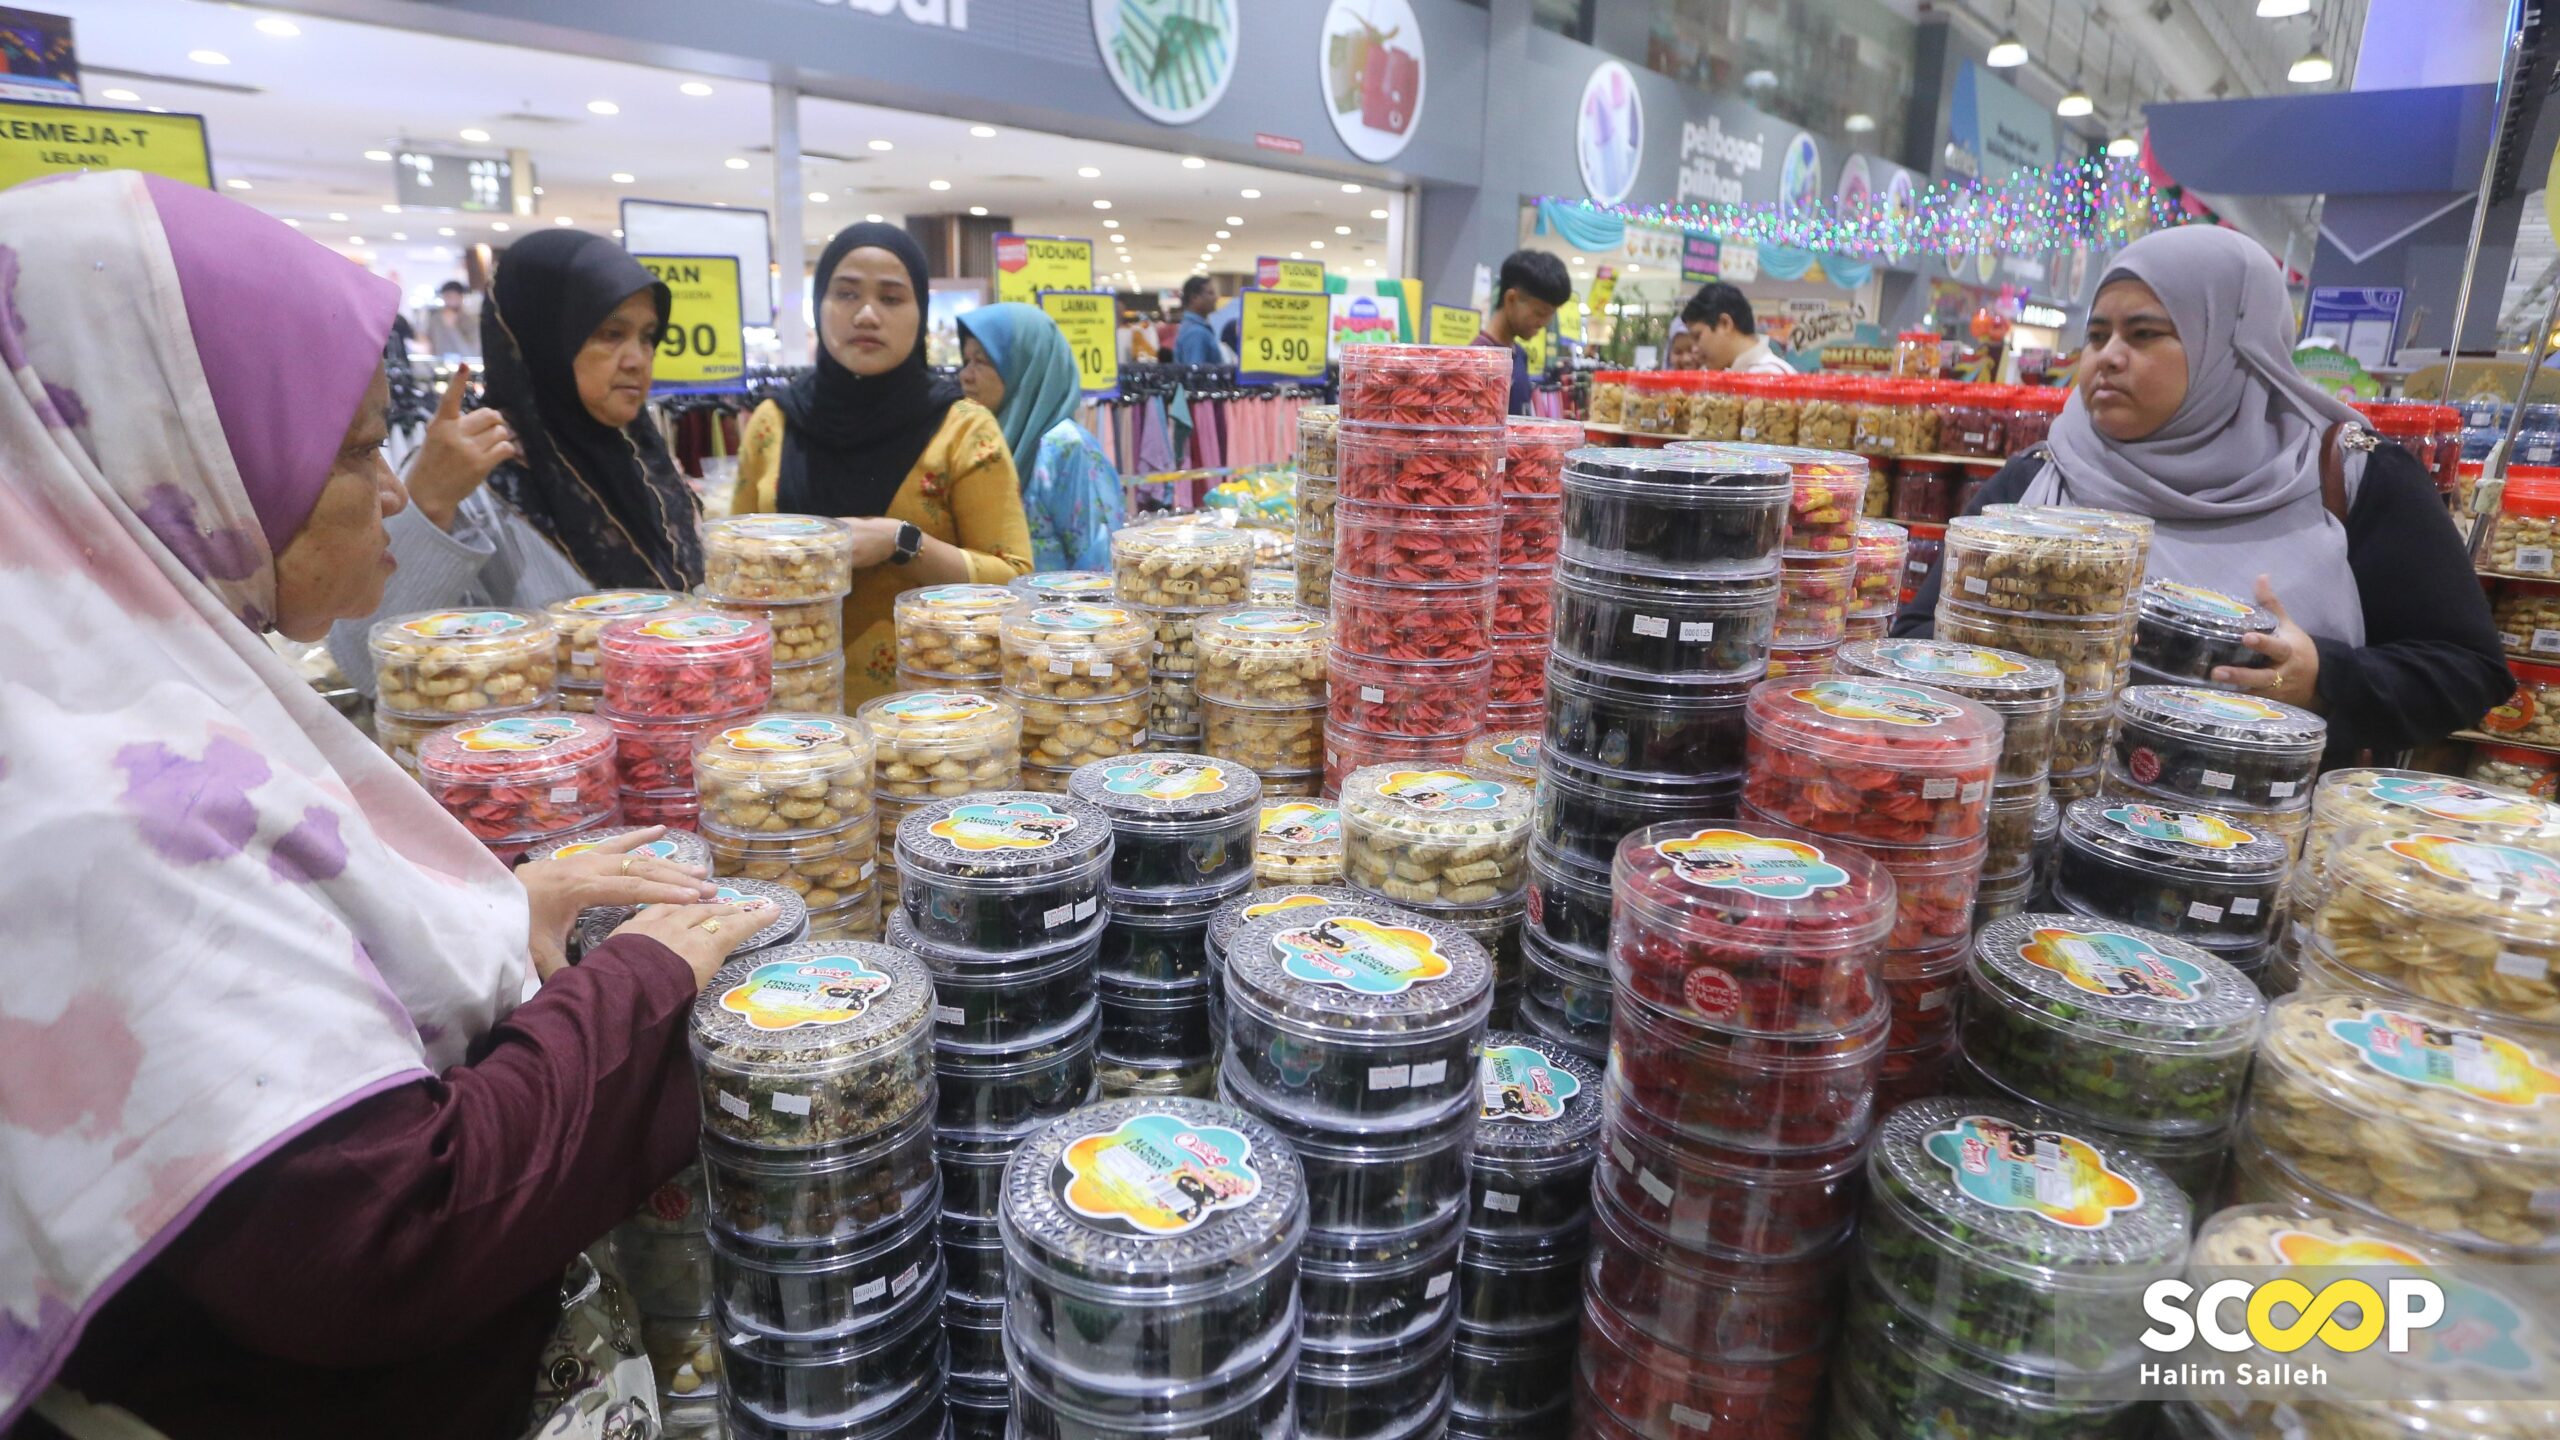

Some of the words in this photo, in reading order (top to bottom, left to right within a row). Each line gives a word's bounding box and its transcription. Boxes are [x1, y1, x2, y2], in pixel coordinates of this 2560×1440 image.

[1681, 116, 1764, 175] pelbagai
[1028, 244, 1088, 260] TUDUNG
[1079, 348, 1102, 374] 10
[1260, 336, 1309, 361] 9.90
[1134, 1138, 1173, 1168] ALMOND
